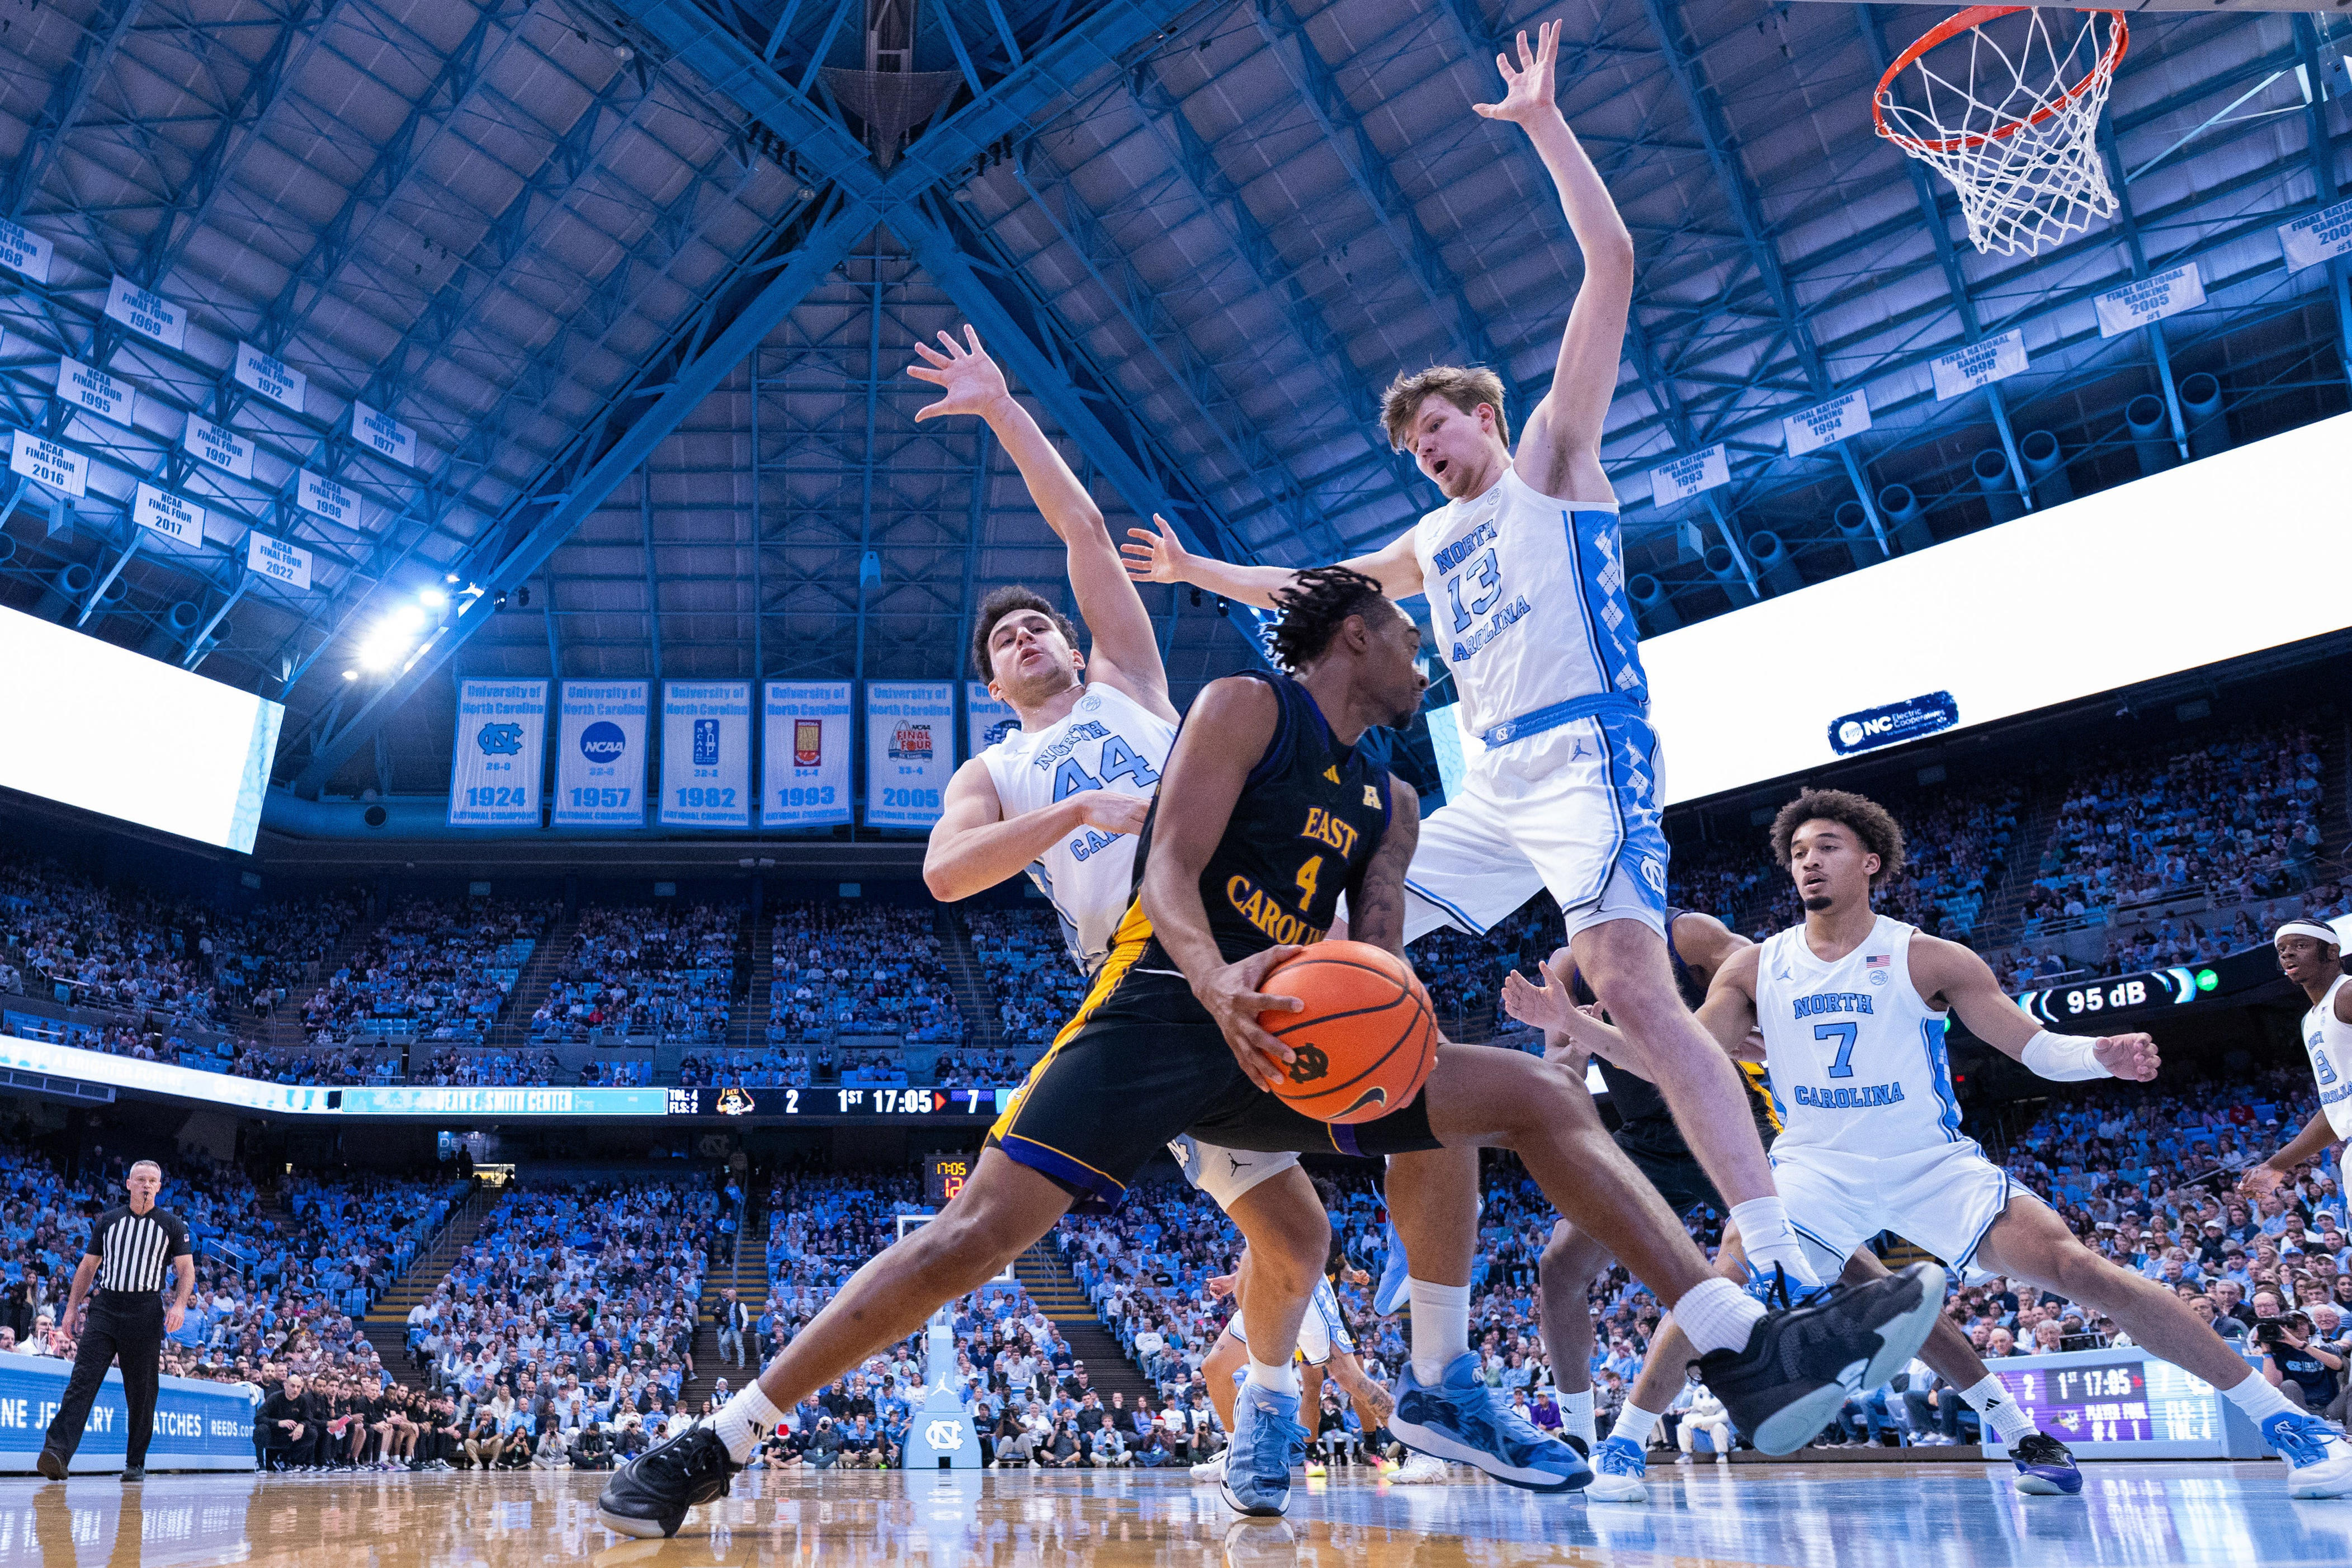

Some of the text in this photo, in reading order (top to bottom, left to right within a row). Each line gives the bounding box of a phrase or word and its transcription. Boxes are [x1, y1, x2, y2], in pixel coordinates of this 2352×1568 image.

[2292, 213, 2321, 232] FINAL
[2107, 268, 2185, 301] FINAL NATIONAL
[2124, 284, 2170, 305] RANKING
[122, 292, 173, 325] FINAL FOUR
[2130, 294, 2169, 315] 2005
[130, 311, 161, 336] 1969
[2147, 310, 2161, 321] #1
[1941, 335, 2010, 365] FINAL NATIONAL
[1957, 348, 1997, 369] RANKING
[1963, 359, 1996, 378] 1998
[73, 372, 122, 402] FINAL FOUR
[258, 377, 283, 399] 1972
[1976, 375, 1988, 385] #1
[81, 391, 111, 413] 1995
[1793, 395, 1854, 423] FINAL NATIONAL
[1807, 408, 1844, 427] RANKING
[1813, 418, 1842, 436] 1994
[197, 429, 242, 457] FINAL FOUR
[1824, 433, 1835, 442] #1
[39, 441, 64, 458] NCAA
[206, 447, 232, 466] 1997
[26, 447, 74, 473] FINAL FOUR
[1659, 448, 1714, 475] FINAL NATIONAL
[1672, 462, 1704, 478] RANKING
[32, 464, 64, 485] 2016
[1676, 471, 1703, 488] 1993
[310, 483, 351, 508] FINAL FOUR
[1687, 485, 1697, 494] #1
[149, 498, 192, 523] FINAL FOUR
[161, 493, 182, 509] NCAA
[317, 499, 342, 518] 1998
[155, 516, 182, 535] 2017
[260, 546, 301, 568] FINAL FOUR
[271, 540, 292, 555] NCAA
[1433, 519, 1497, 575] NORTH
[266, 561, 293, 580] 2022
[1448, 548, 1501, 634] 13
[1453, 595, 1530, 662] AROLINA
[467, 686, 541, 698] University of
[568, 687, 641, 699] University of
[671, 687, 744, 699] University of
[772, 687, 845, 699] University of
[874, 687, 946, 699] University of
[462, 702, 544, 714] North Carolina
[564, 703, 646, 715] North Carolina
[666, 703, 748, 715] North Carolina
[767, 703, 849, 715] North Carolina
[870, 703, 950, 716] North Carolina
[971, 702, 1000, 712] North
[1863, 716, 1892, 736] NC
[1892, 709, 1921, 720] Electric
[898, 731, 929, 740] FINAL
[1035, 720, 1111, 771] NORTH
[584, 742, 624, 752] NCAA
[902, 741, 932, 751] FOUR
[1052, 735, 1161, 804] 44
[466, 787, 526, 806] 1924
[570, 787, 631, 807] 1957
[676, 787, 736, 807] 1982
[778, 786, 835, 806] 1993
[884, 788, 939, 807] 2005
[1301, 807, 1358, 858] EAST
[1296, 855, 1323, 911] 4
[1793, 993, 1873, 1019] NORTH
[2067, 981, 2146, 1013] 95 dB
[1814, 1022, 1857, 1078] 7
[485, 1091, 523, 1111] SMITH
[528, 1091, 572, 1111] CENTER
[669, 1090, 698, 1101] TOL: 4
[786, 1090, 799, 1113] 2
[838, 1089, 932, 1113] 1ST 17:05
[967, 1090, 979, 1113] 7
[1794, 1082, 1904, 1108] CAROLINA
[669, 1102, 698, 1113] FLS: 2
[937, 1162, 966, 1175] 17:05
[945, 1177, 964, 1199] 12
[2023, 1374, 2035, 1400] 2
[2084, 1368, 2131, 1396] 17:05
[2157, 1365, 2169, 1392] 7
[1, 1399, 27, 1429] NE
[2200, 1399, 2208, 1419] 1
[2131, 1420, 2140, 1441] 1
[2201, 1418, 2211, 1439] 4
